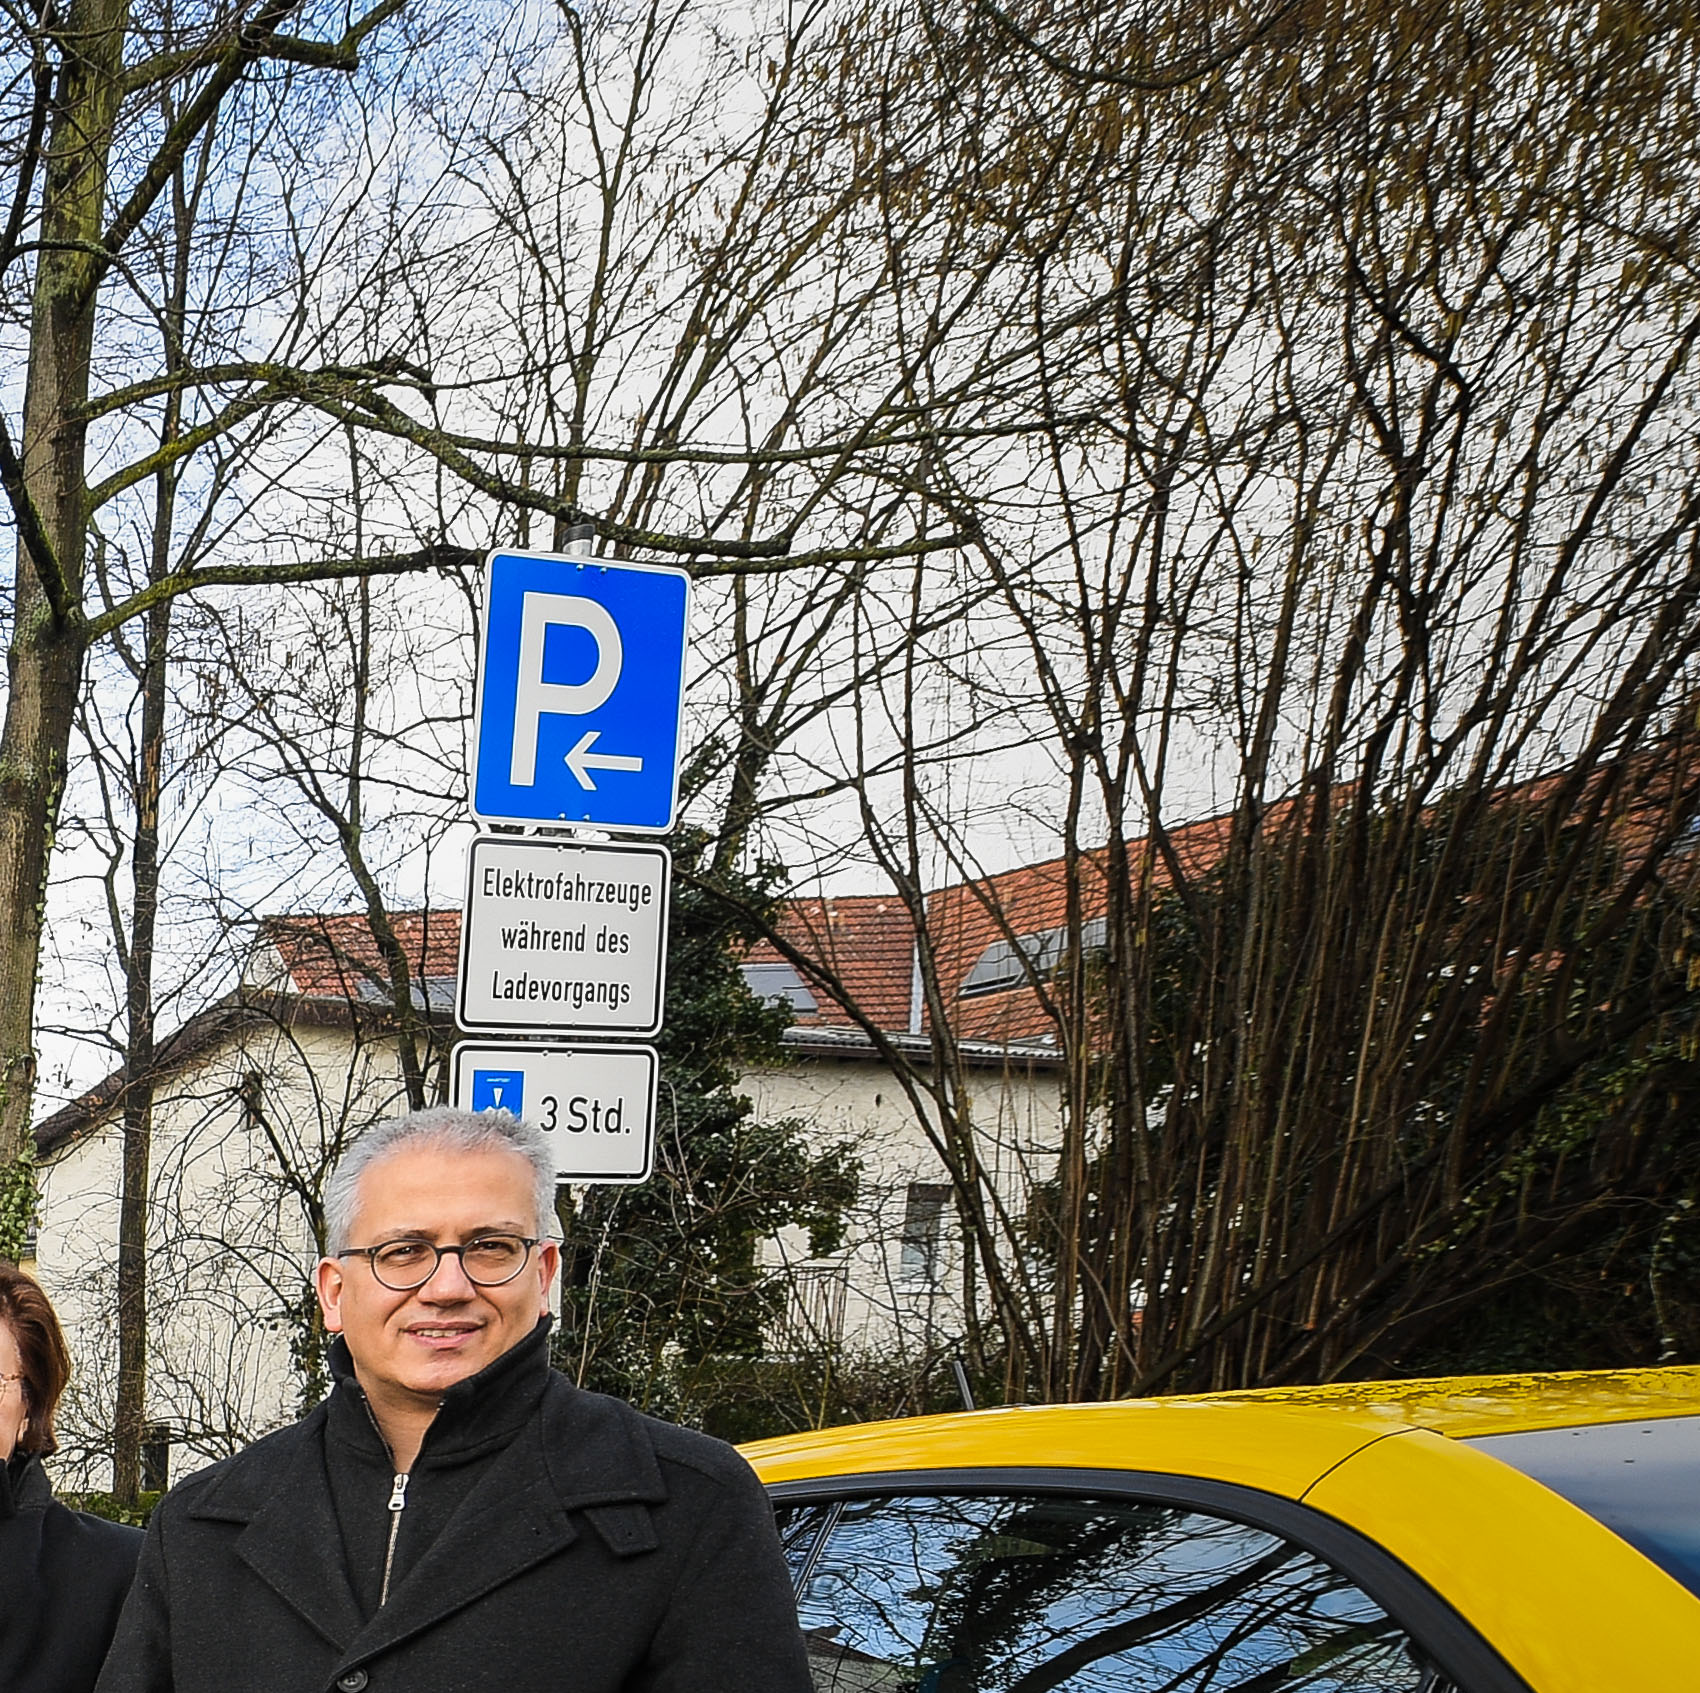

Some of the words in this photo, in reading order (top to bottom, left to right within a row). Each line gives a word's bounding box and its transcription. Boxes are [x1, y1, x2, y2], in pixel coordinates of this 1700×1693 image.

[510, 591, 623, 787] P
[483, 868, 652, 912] Elektrofahrzeuge
[501, 920, 586, 952] während
[596, 925, 629, 954] des
[492, 970, 631, 1011] Ladevorgangs
[539, 1095, 558, 1132] 3
[566, 1096, 631, 1134] Std.
